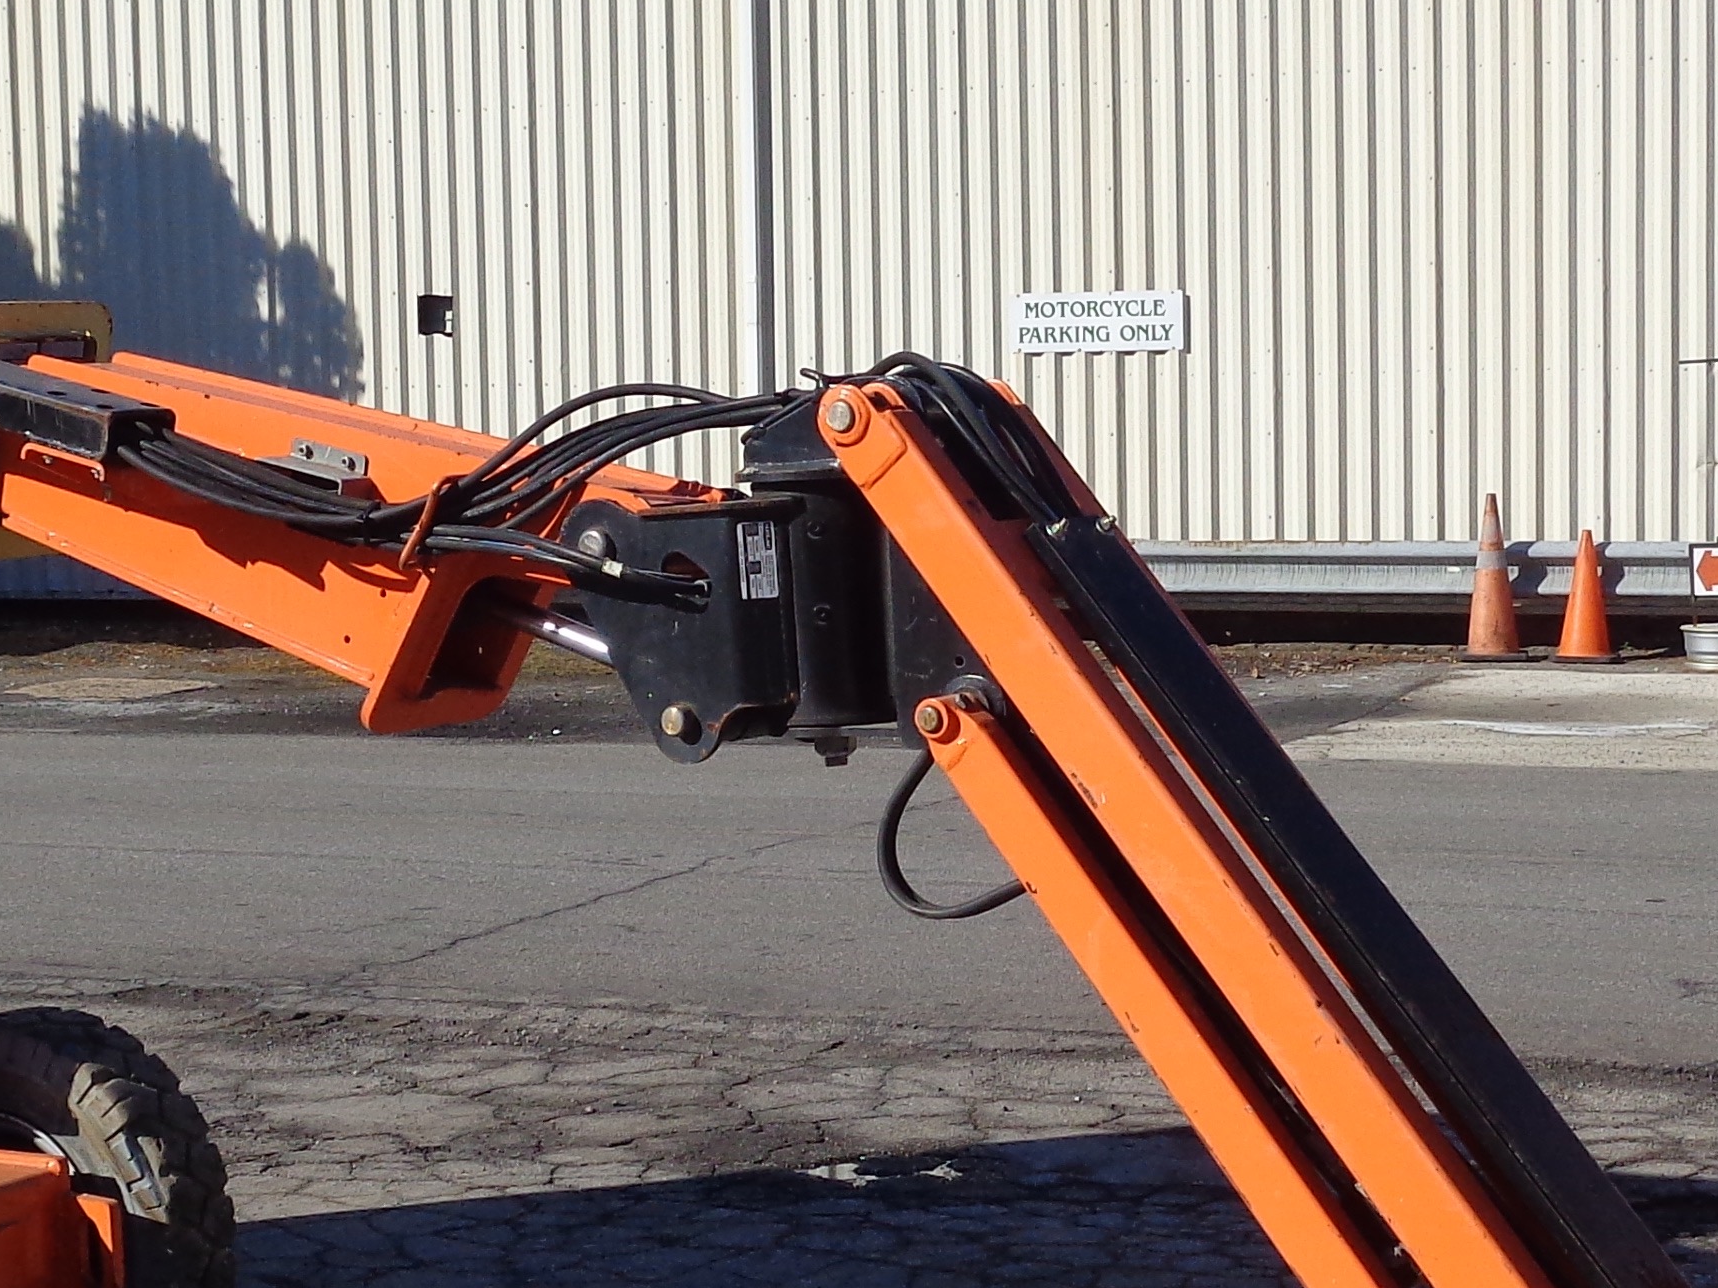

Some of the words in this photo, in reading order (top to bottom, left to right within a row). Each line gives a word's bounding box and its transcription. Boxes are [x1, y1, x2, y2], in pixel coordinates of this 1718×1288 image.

[1025, 299, 1166, 318] MOTORCYCLE
[1019, 325, 1110, 343] PARKING
[1120, 324, 1174, 341] ONLY
